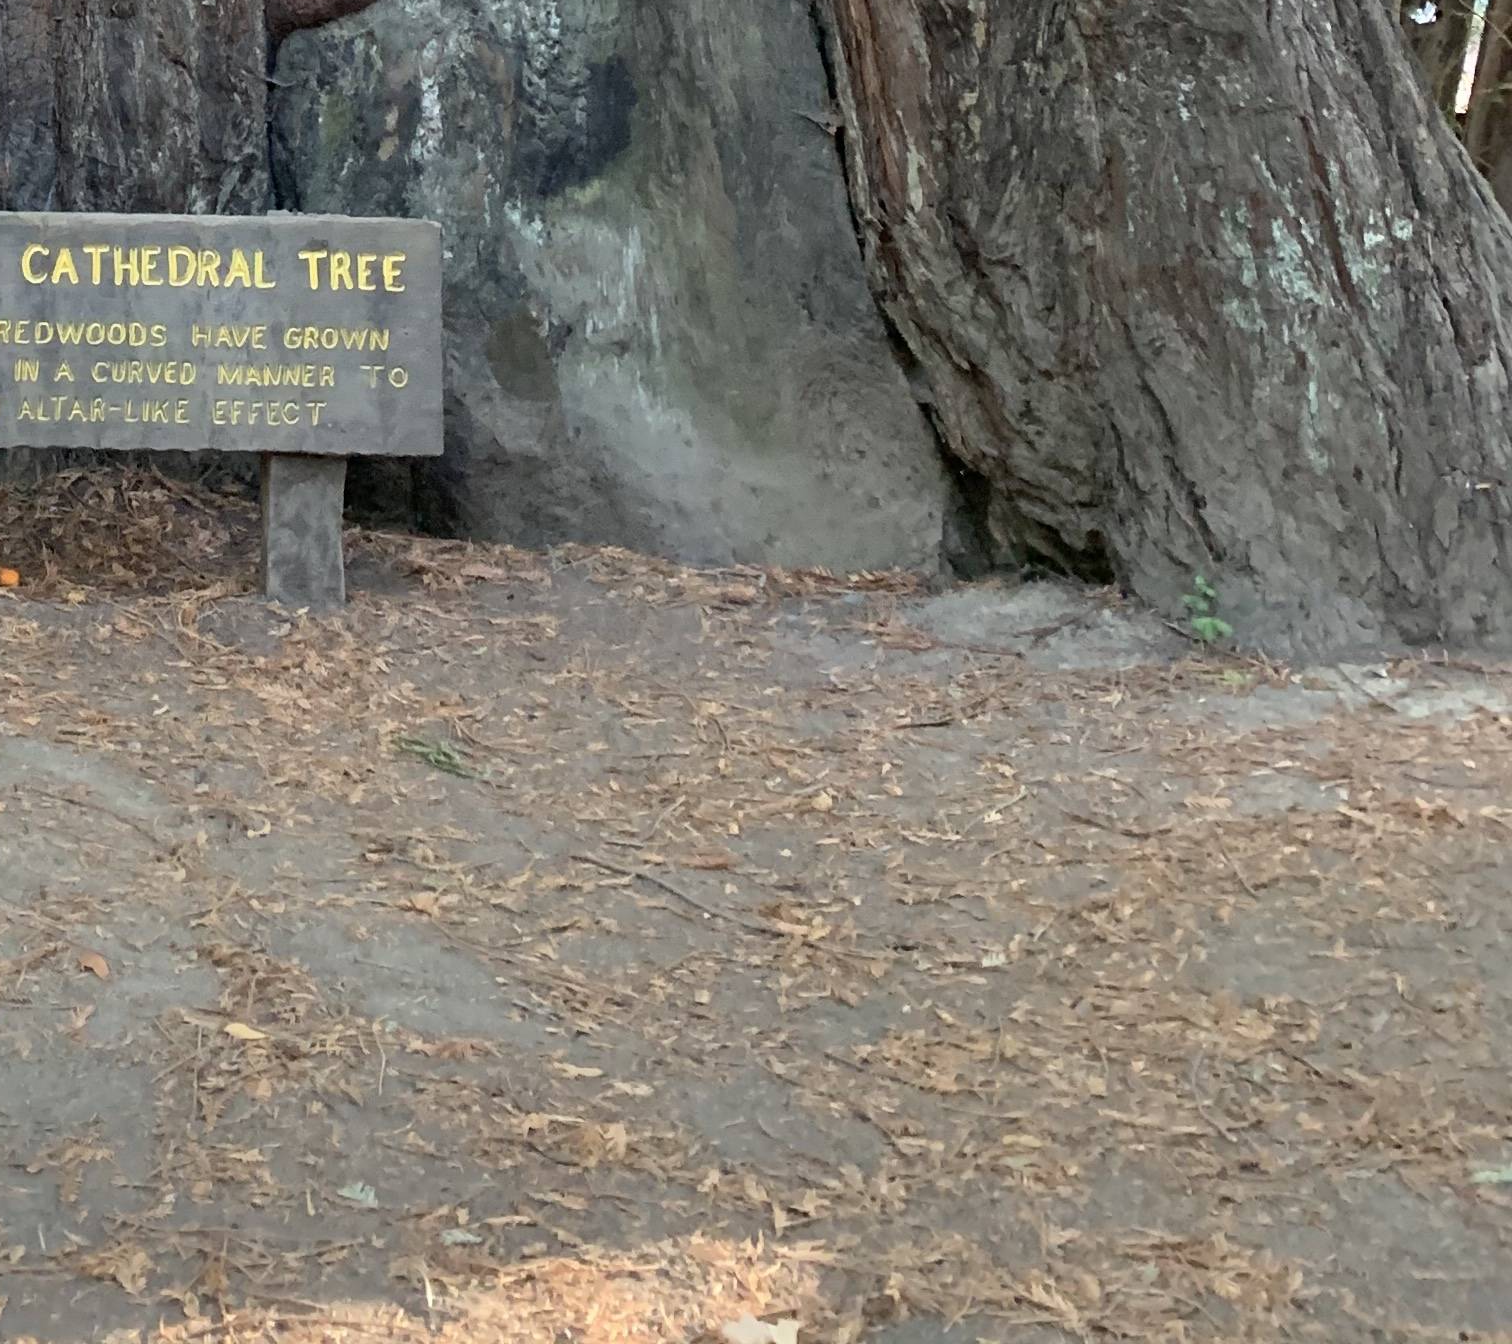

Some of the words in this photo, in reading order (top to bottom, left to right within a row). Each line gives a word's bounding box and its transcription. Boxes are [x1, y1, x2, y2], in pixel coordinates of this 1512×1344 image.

[21, 244, 275, 290] CATHEDRAL
[299, 249, 407, 293] TREE
[192, 323, 266, 350] HAVE
[283, 326, 390, 352] GROWN
[14, 358, 39, 382] IN
[55, 361, 74, 383] A
[91, 360, 196, 386] CURVED
[217, 364, 335, 388] MANNER
[360, 365, 408, 388] TO
[18, 396, 190, 425] ALTAR-LIKE
